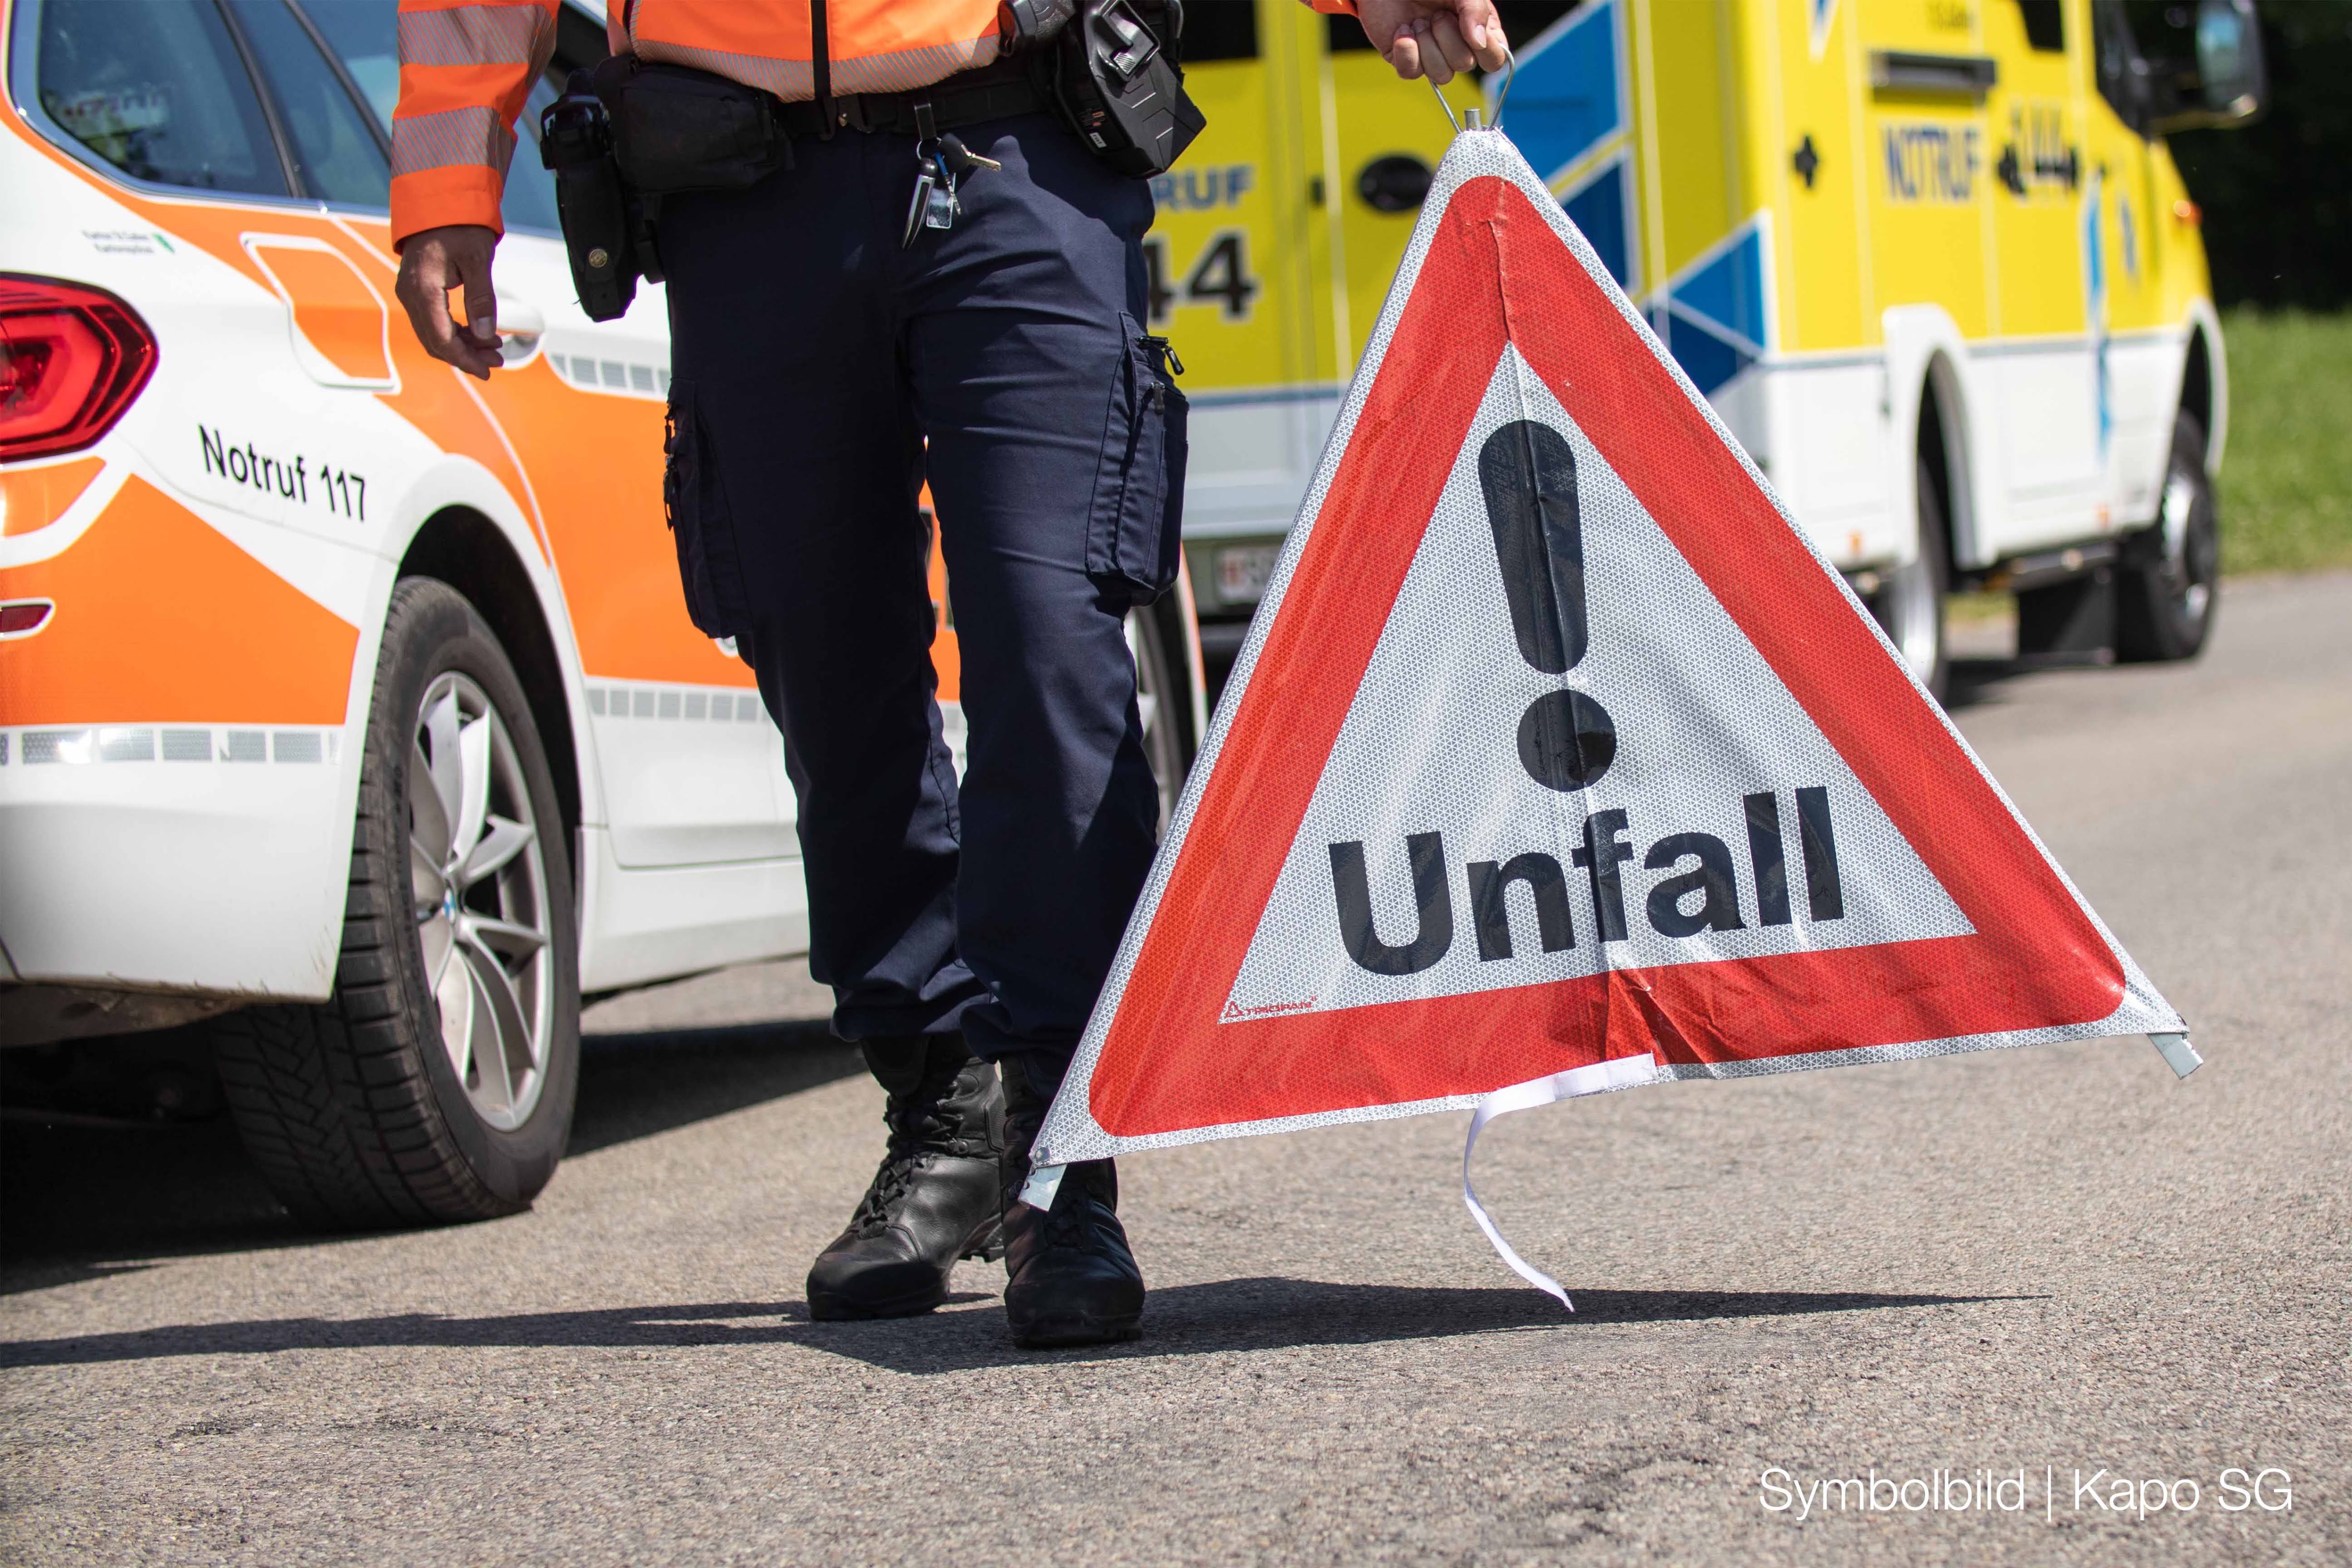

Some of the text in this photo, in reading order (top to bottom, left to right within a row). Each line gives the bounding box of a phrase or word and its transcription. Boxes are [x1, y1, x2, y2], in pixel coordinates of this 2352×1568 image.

[198, 424, 366, 522] Notruf 117
[1328, 786, 1844, 976] Unfall
